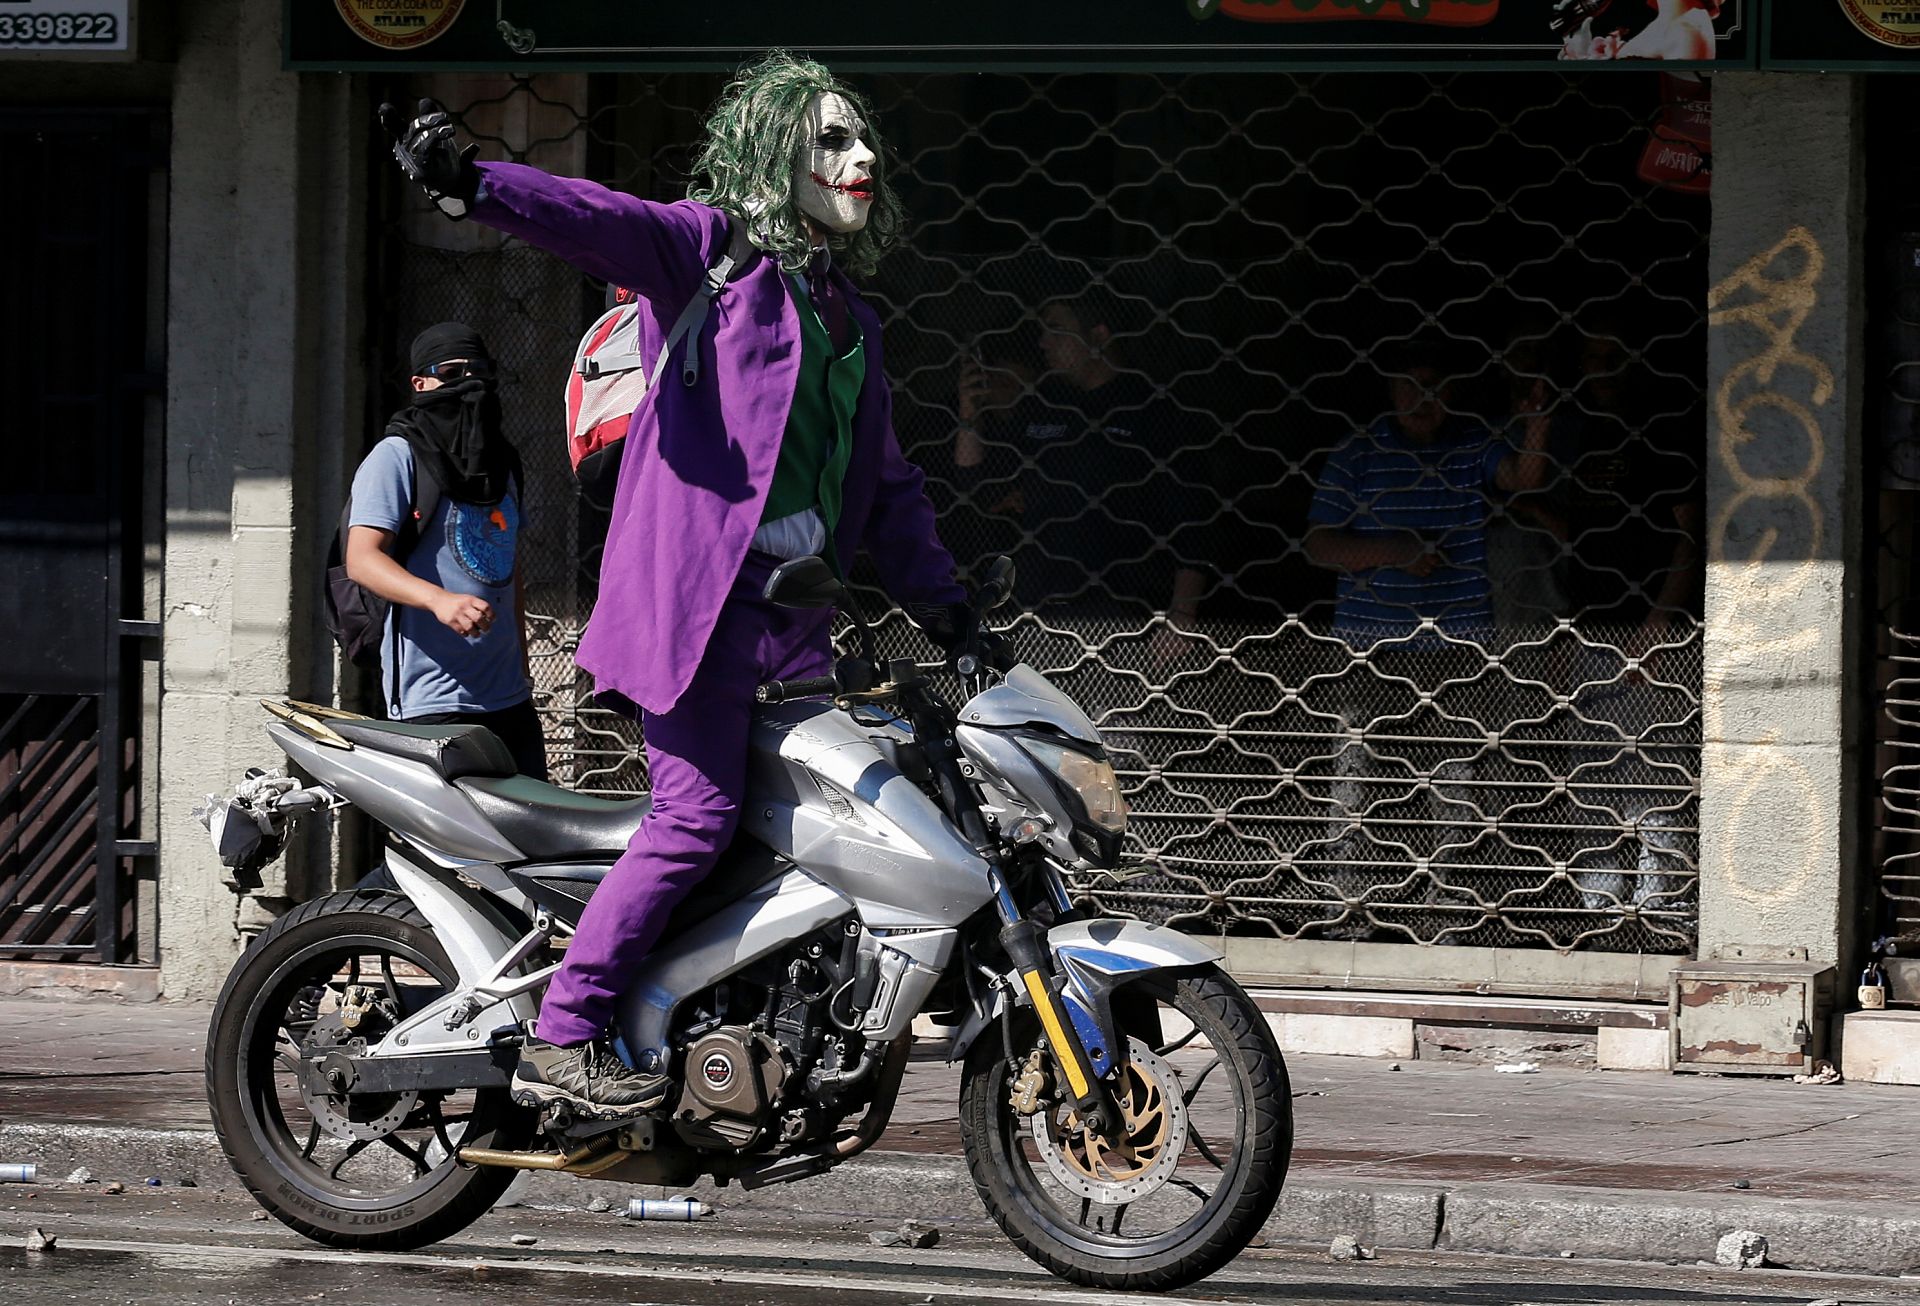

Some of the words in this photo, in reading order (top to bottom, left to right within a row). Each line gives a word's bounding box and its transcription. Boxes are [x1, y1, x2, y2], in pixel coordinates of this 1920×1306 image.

[0, 14, 114, 41] 339822
[374, 15, 425, 26] ATLANTA
[975, 1092, 993, 1164] SPORT
[276, 1182, 341, 1223] DEMON
[348, 1204, 416, 1226] SPORT
